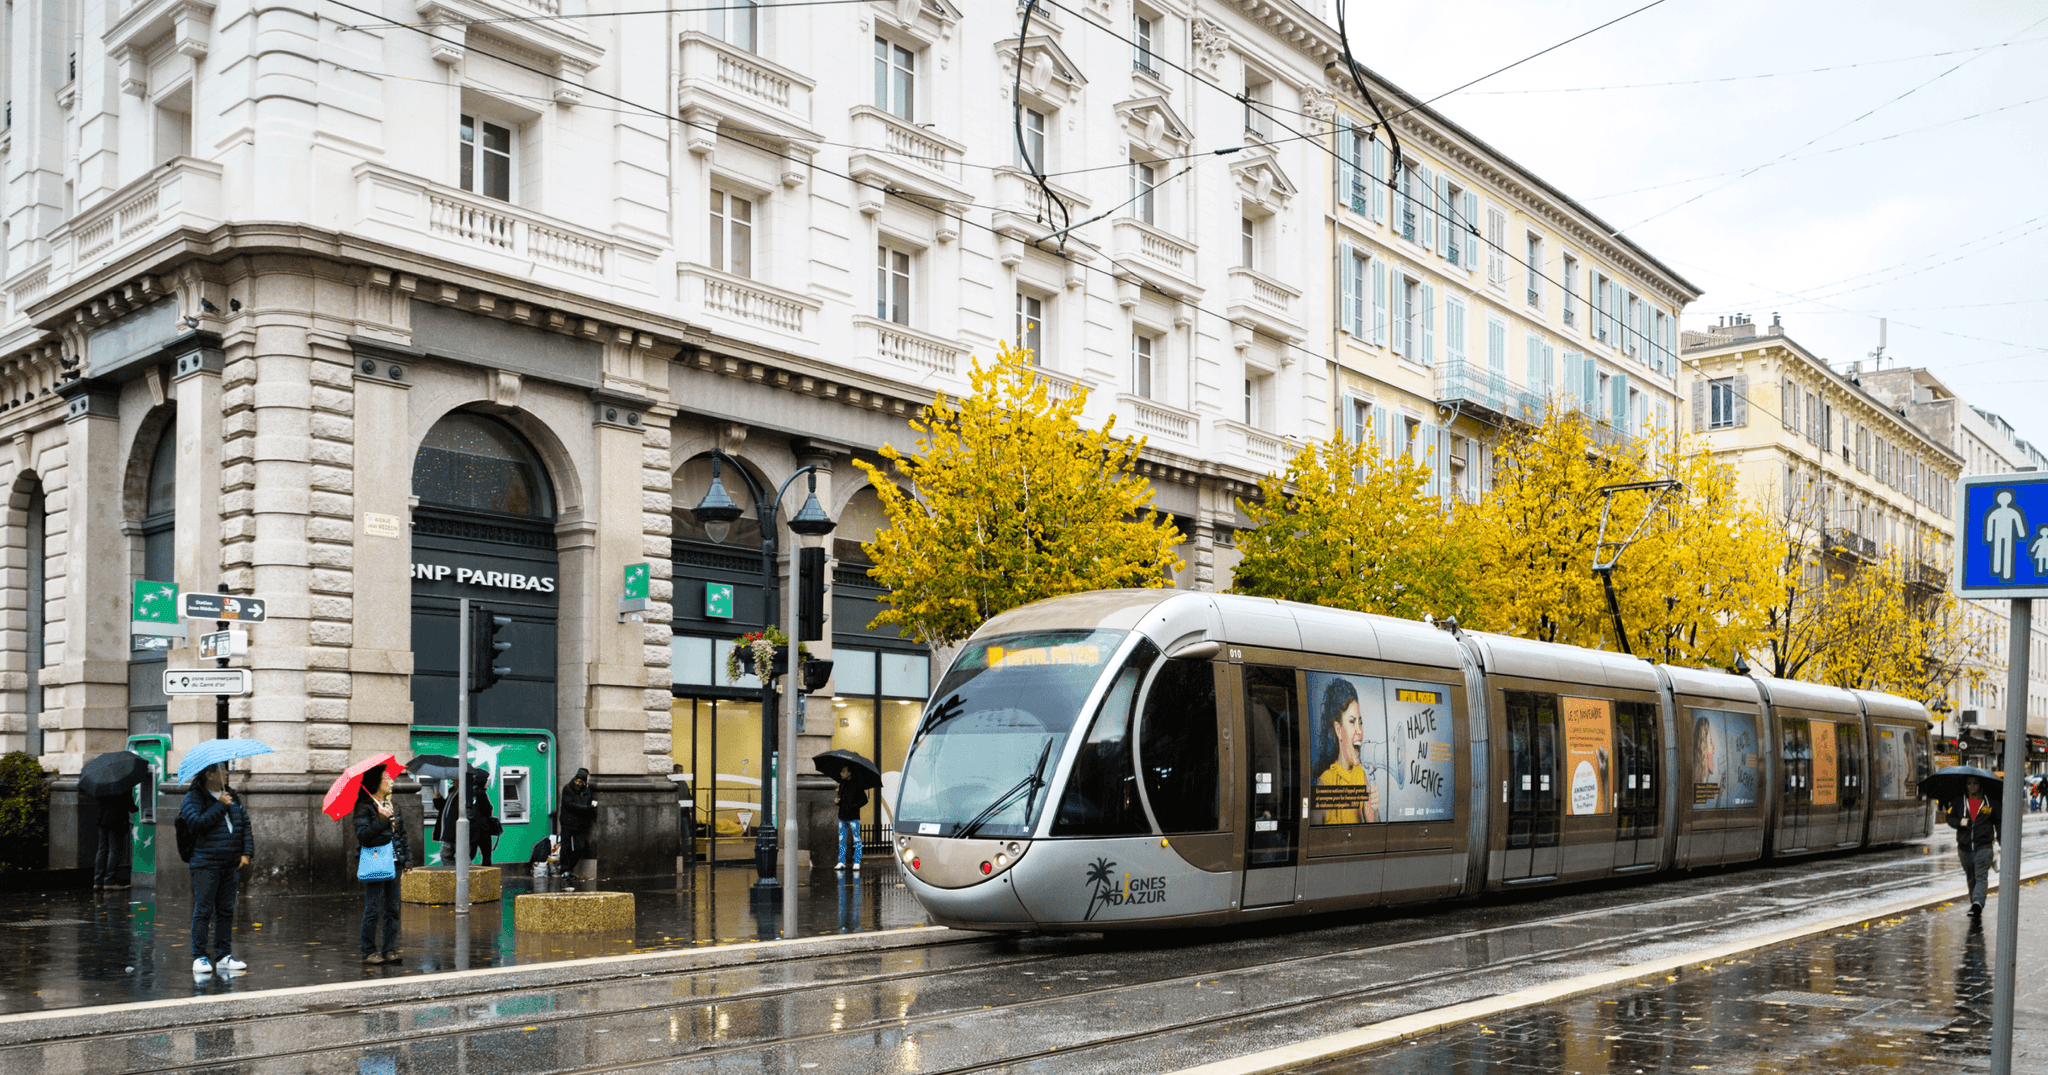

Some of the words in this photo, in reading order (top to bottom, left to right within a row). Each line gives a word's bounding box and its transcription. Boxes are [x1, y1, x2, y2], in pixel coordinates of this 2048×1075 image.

[457, 568, 555, 592] PARIBAS
[1230, 649, 1242, 658] 010
[1407, 708, 1437, 740] HALTE
[1418, 741, 1428, 760] AU
[1410, 760, 1444, 798] SILENCE
